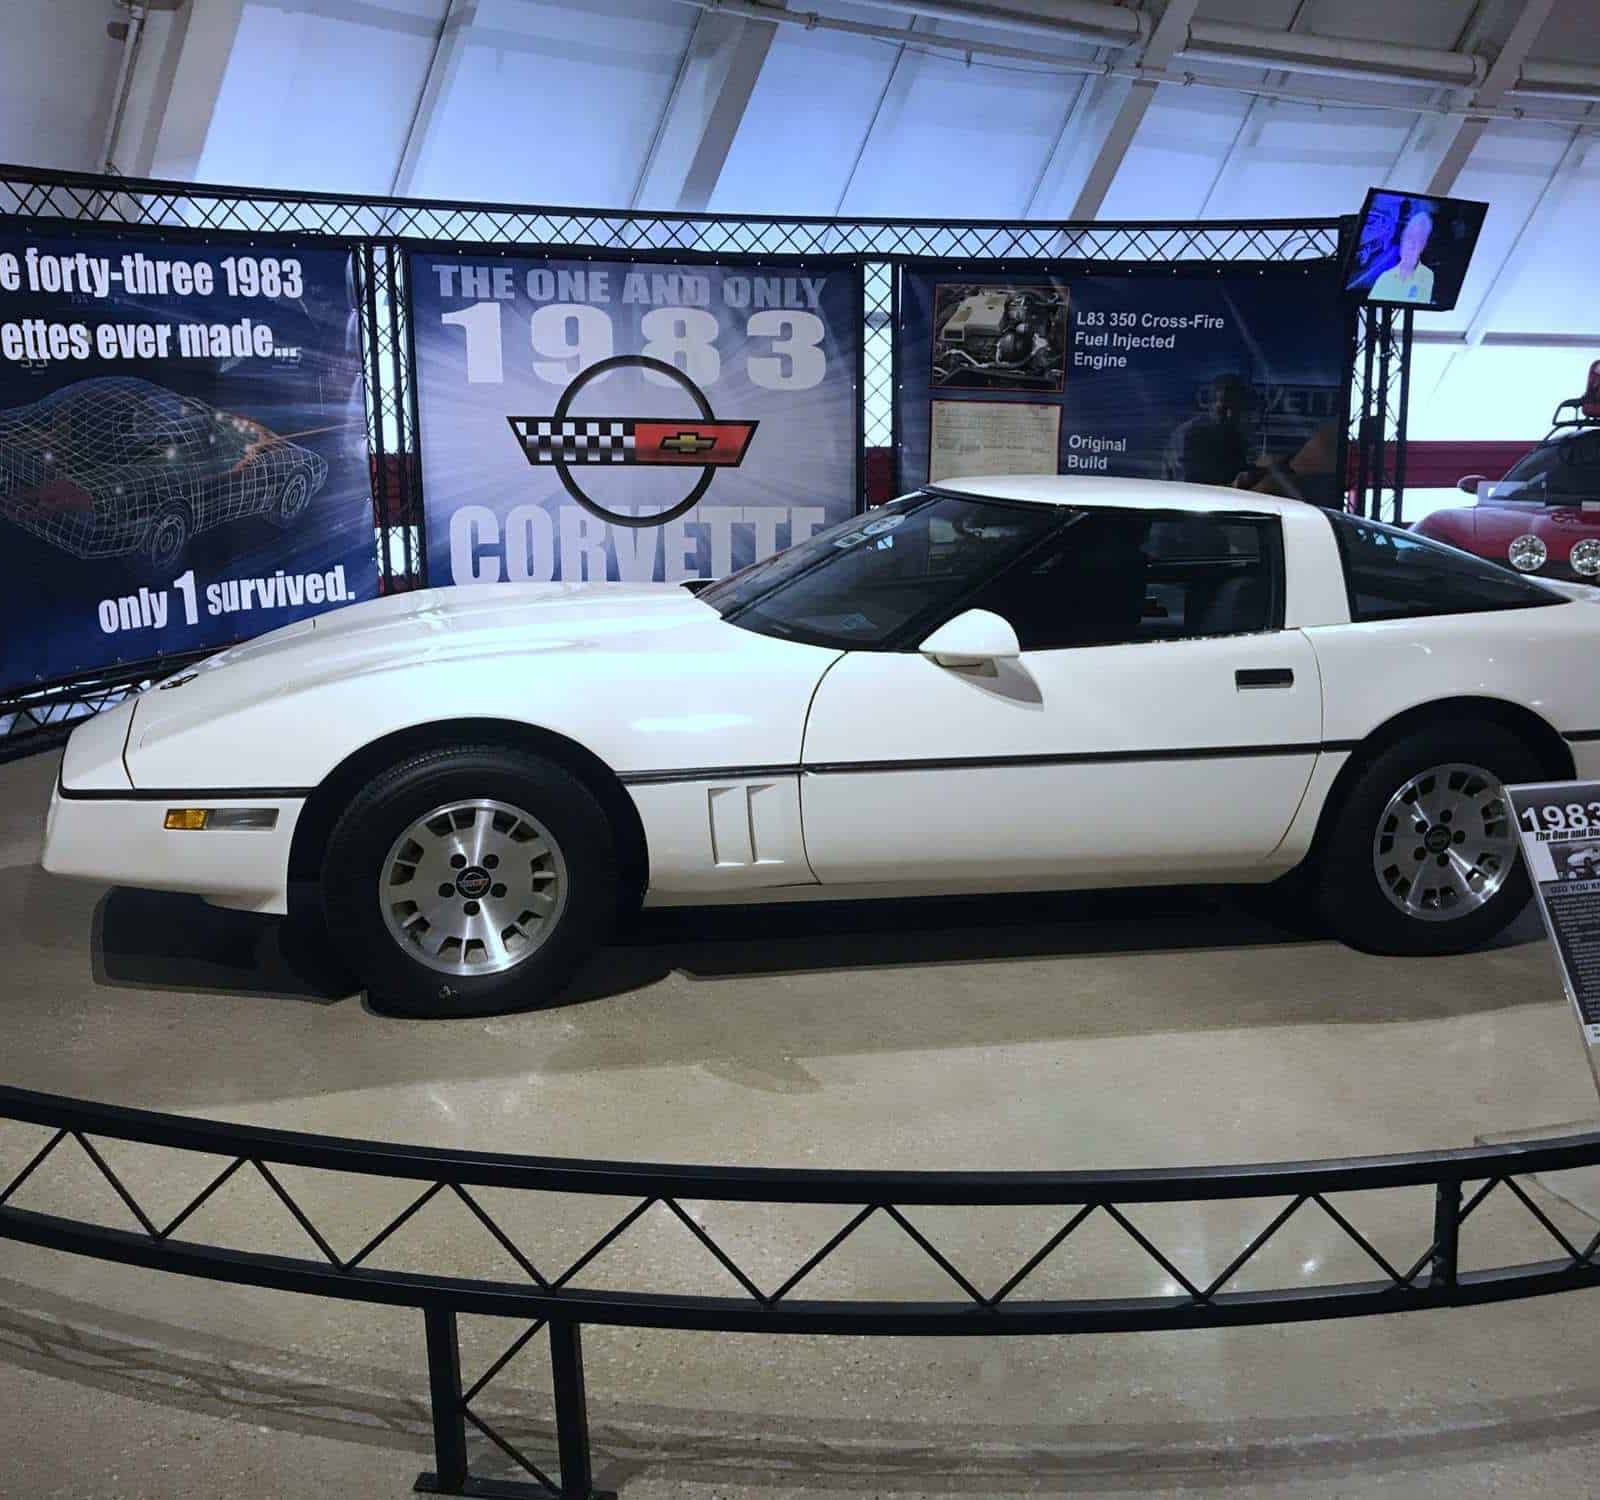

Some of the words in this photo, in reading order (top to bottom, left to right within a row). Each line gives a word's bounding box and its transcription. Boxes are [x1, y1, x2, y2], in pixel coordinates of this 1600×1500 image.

[25, 247, 214, 298] forty-three
[221, 256, 303, 298] 1983
[432, 264, 516, 300] THE
[527, 269, 610, 303] ONE
[622, 273, 710, 306] AND
[723, 276, 827, 310] ONLY
[1077, 312, 1105, 326] L83
[1109, 312, 1137, 327] 350
[1141, 313, 1225, 329] Cross-Fire
[1, 318, 90, 360] ettes
[96, 323, 171, 359] ever
[179, 318, 297, 358] made...
[441, 302, 827, 391] 1983
[1075, 332, 1108, 346] Fuel
[1112, 333, 1176, 351] Injected
[1074, 352, 1128, 370] Engine
[1069, 434, 1127, 453] Original
[1067, 454, 1108, 470] Build
[98, 587, 168, 633] only
[173, 570, 199, 625] 1
[206, 565, 355, 615] survived.
[1521, 802, 1600, 833] 1983
